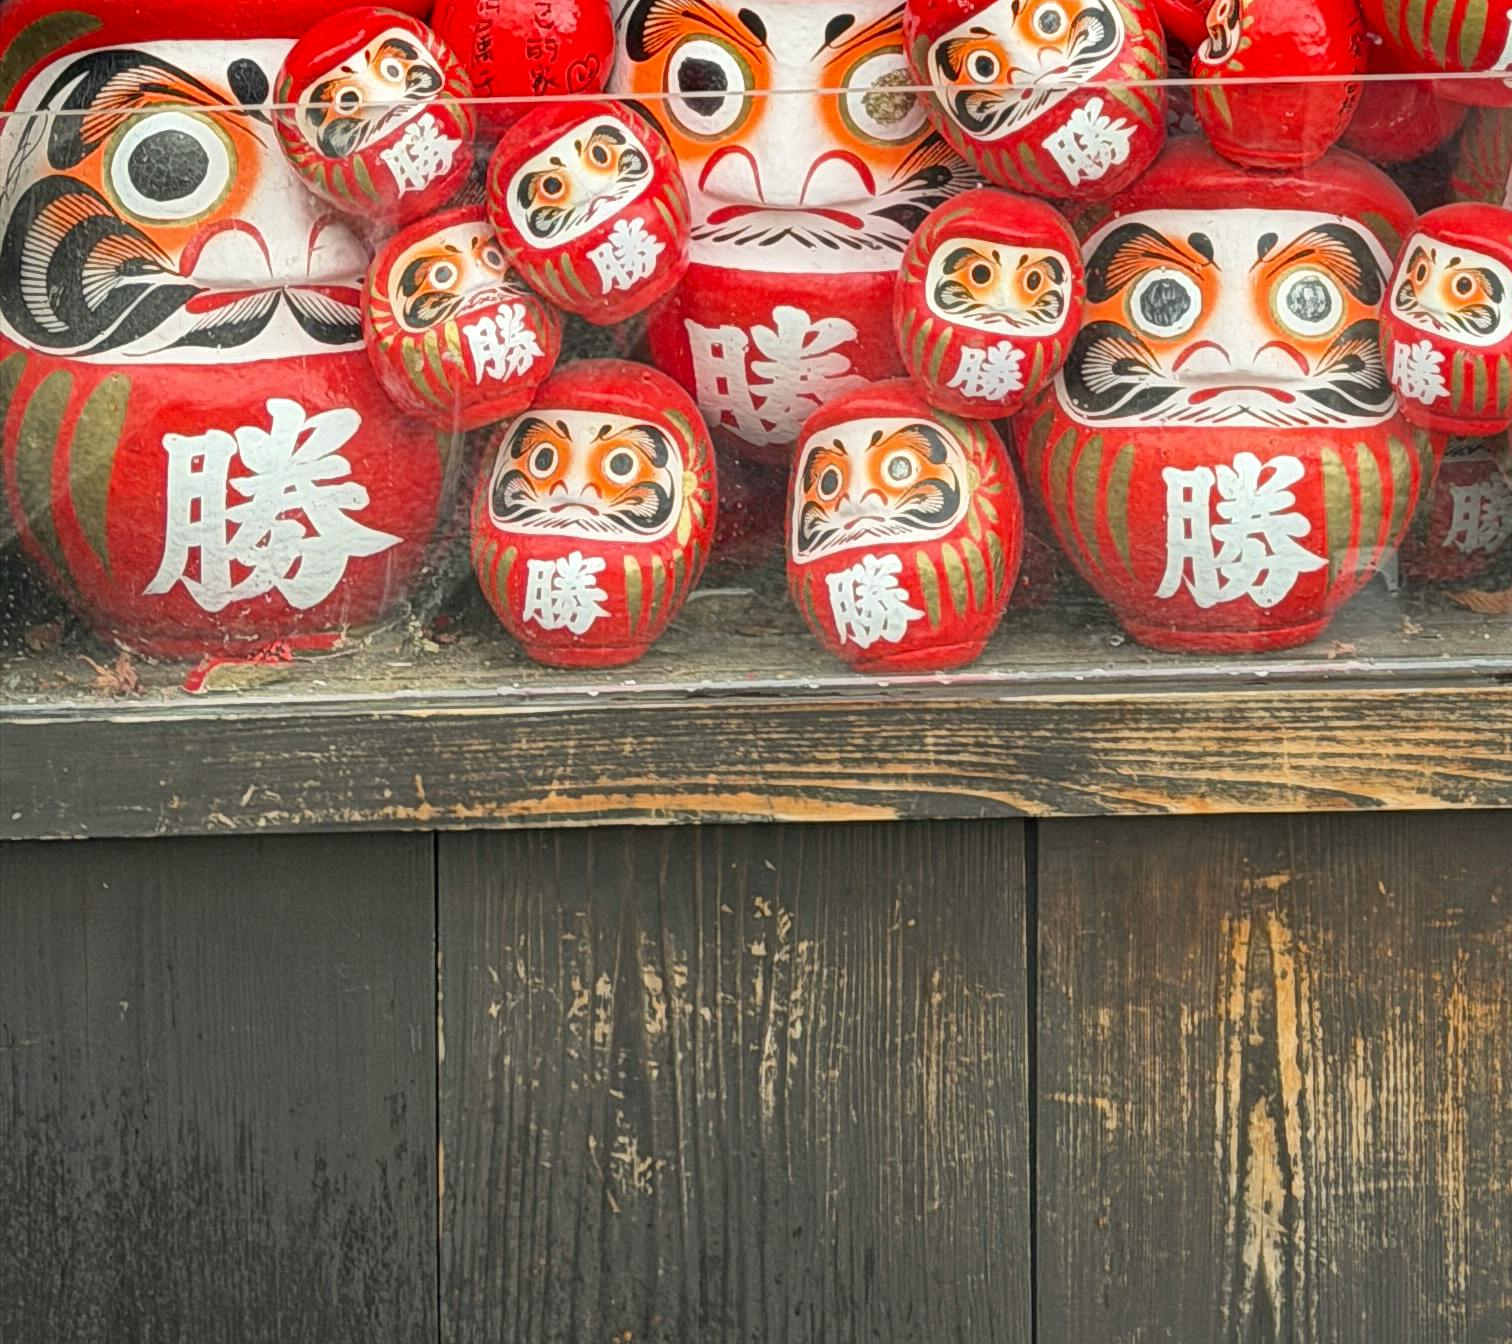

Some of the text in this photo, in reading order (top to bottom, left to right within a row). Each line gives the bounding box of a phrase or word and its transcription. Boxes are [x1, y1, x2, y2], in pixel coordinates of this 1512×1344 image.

[380, 113, 462, 198] 勝
[1040, 97, 1138, 186] 勝
[586, 218, 665, 294] 勝
[462, 303, 544, 385] 勝
[684, 305, 872, 446] 勝
[947, 340, 1025, 401] 勝
[1391, 339, 1450, 405] 勝
[143, 397, 404, 613] 勝
[1154, 451, 1330, 609] 勝
[522, 550, 610, 635] 勝
[824, 553, 925, 649] 勝
